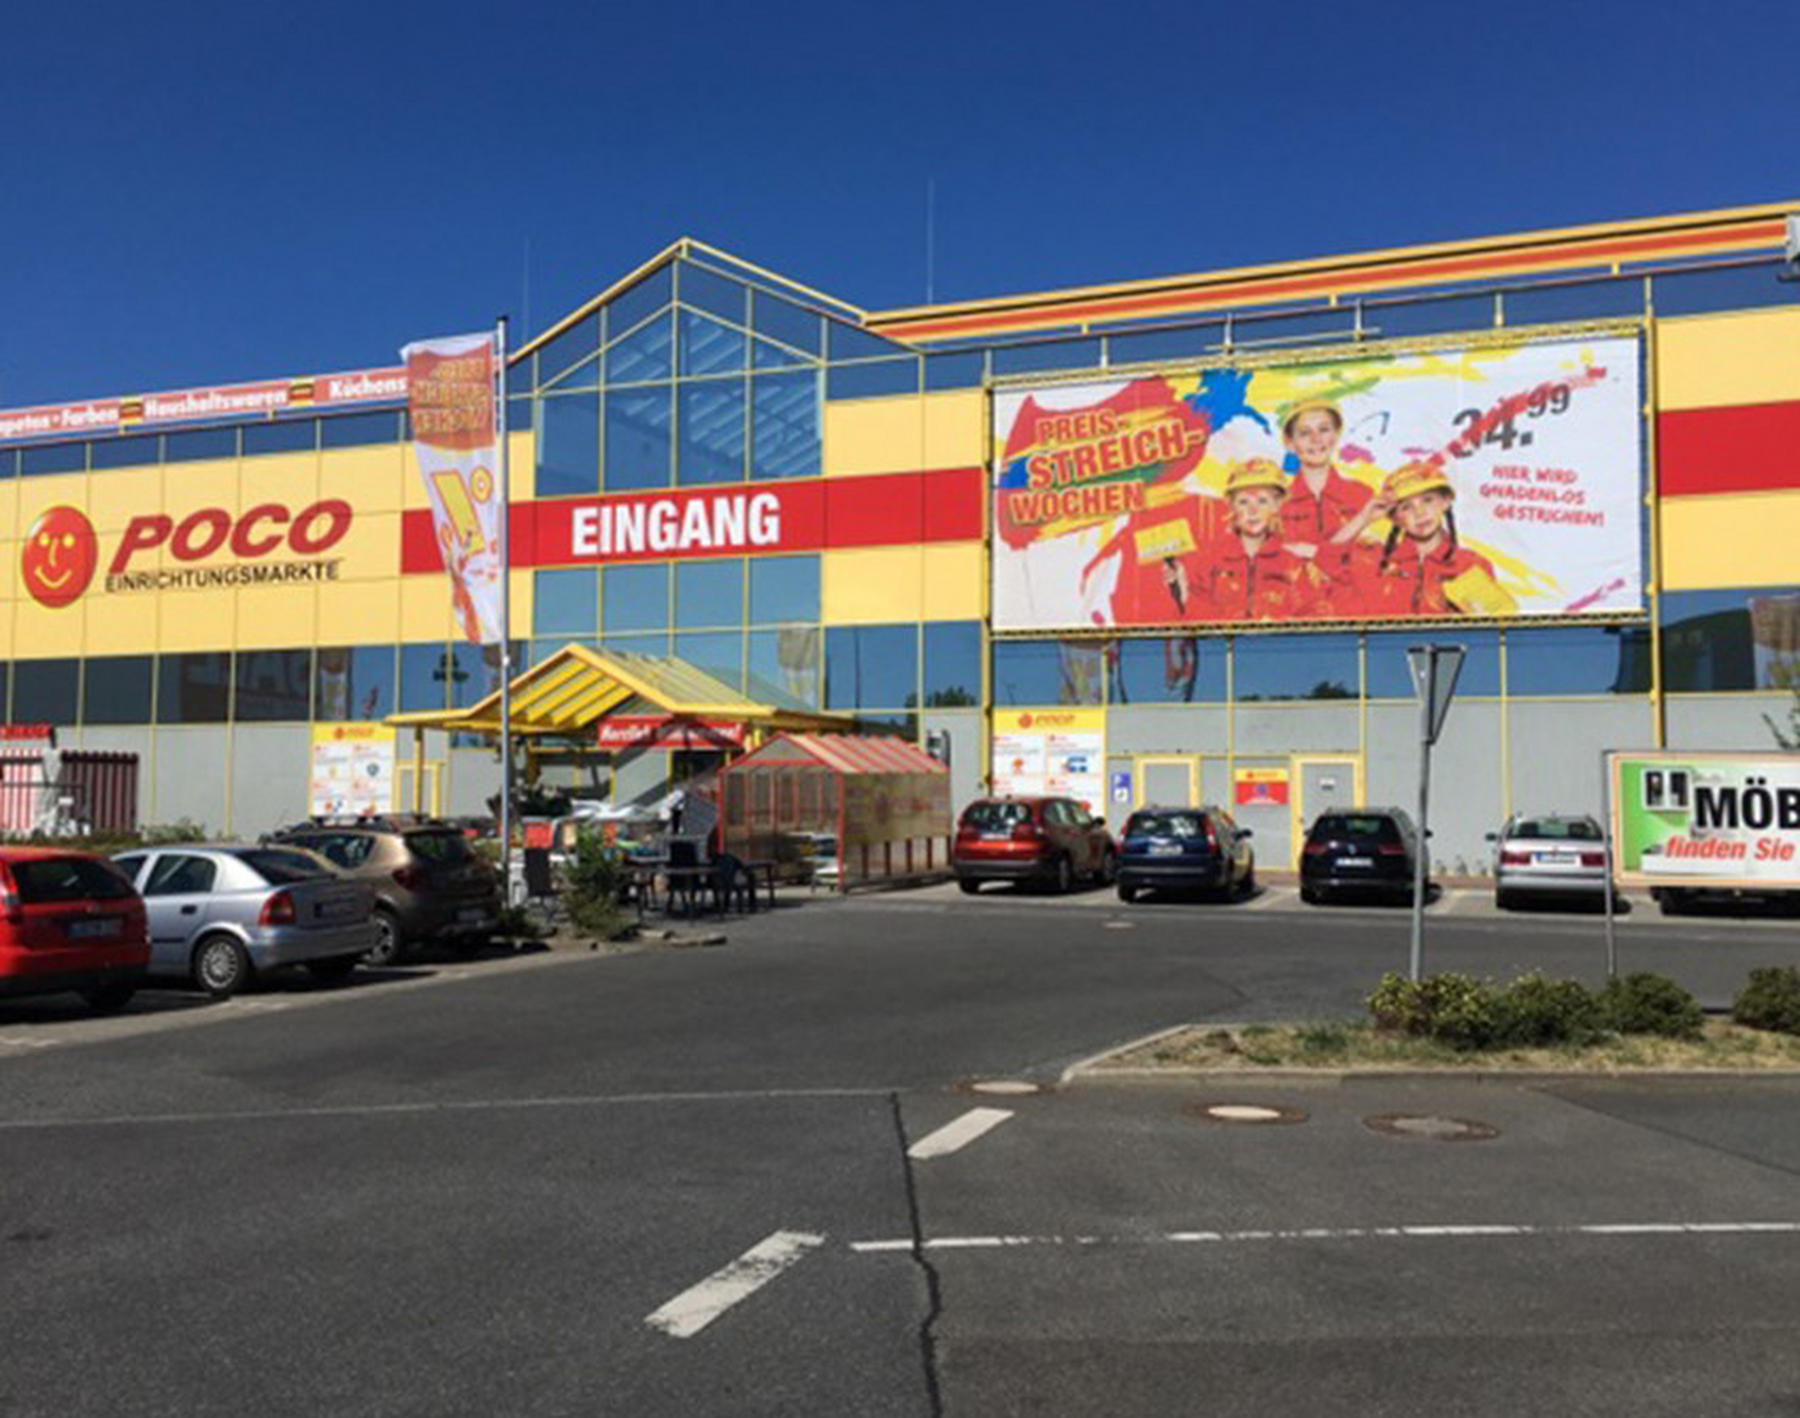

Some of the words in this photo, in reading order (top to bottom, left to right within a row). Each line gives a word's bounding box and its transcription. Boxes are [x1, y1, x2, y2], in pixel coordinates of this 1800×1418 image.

[1029, 418, 1207, 487] STREICH-
[1536, 469, 1577, 485] WIRD
[573, 493, 780, 556] EINGANG
[1009, 481, 1146, 525] WOCHEN
[109, 499, 352, 573] POCO
[106, 561, 339, 593] EINRICHTUNGSMARKTE
[1666, 836, 1746, 859] finden
[1755, 838, 1796, 861] Sie
